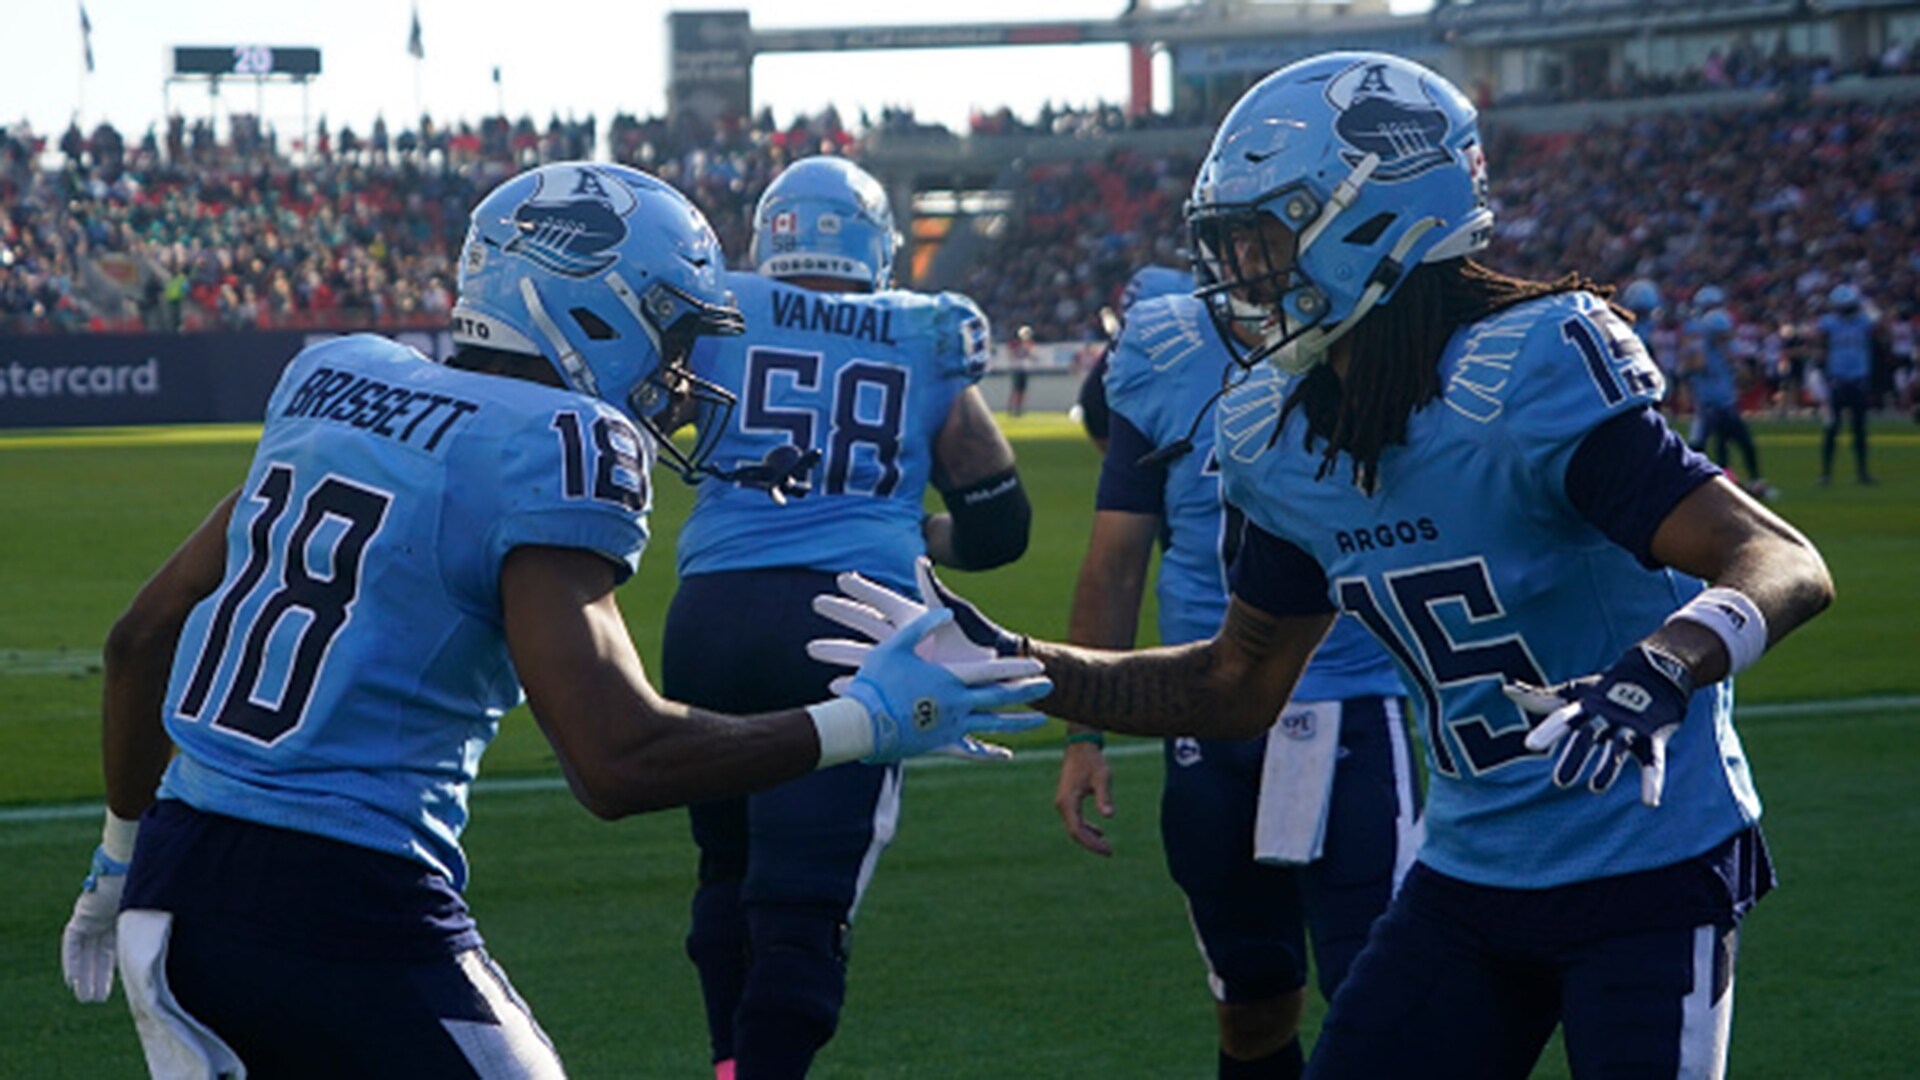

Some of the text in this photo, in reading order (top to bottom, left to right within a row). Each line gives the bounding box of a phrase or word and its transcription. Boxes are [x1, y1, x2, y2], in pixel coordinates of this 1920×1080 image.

[233, 47, 272, 73] 20
[1355, 64, 1393, 92] A
[572, 168, 611, 198] A
[770, 260, 853, 274] TORONTO
[771, 291, 896, 345] VANDAL
[284, 367, 479, 451] BRISSETT
[739, 346, 911, 498] 58
[548, 410, 652, 513] 18
[1336, 517, 1439, 552] ARGOS
[175, 461, 395, 749] 18
[1336, 556, 1558, 778] 15
